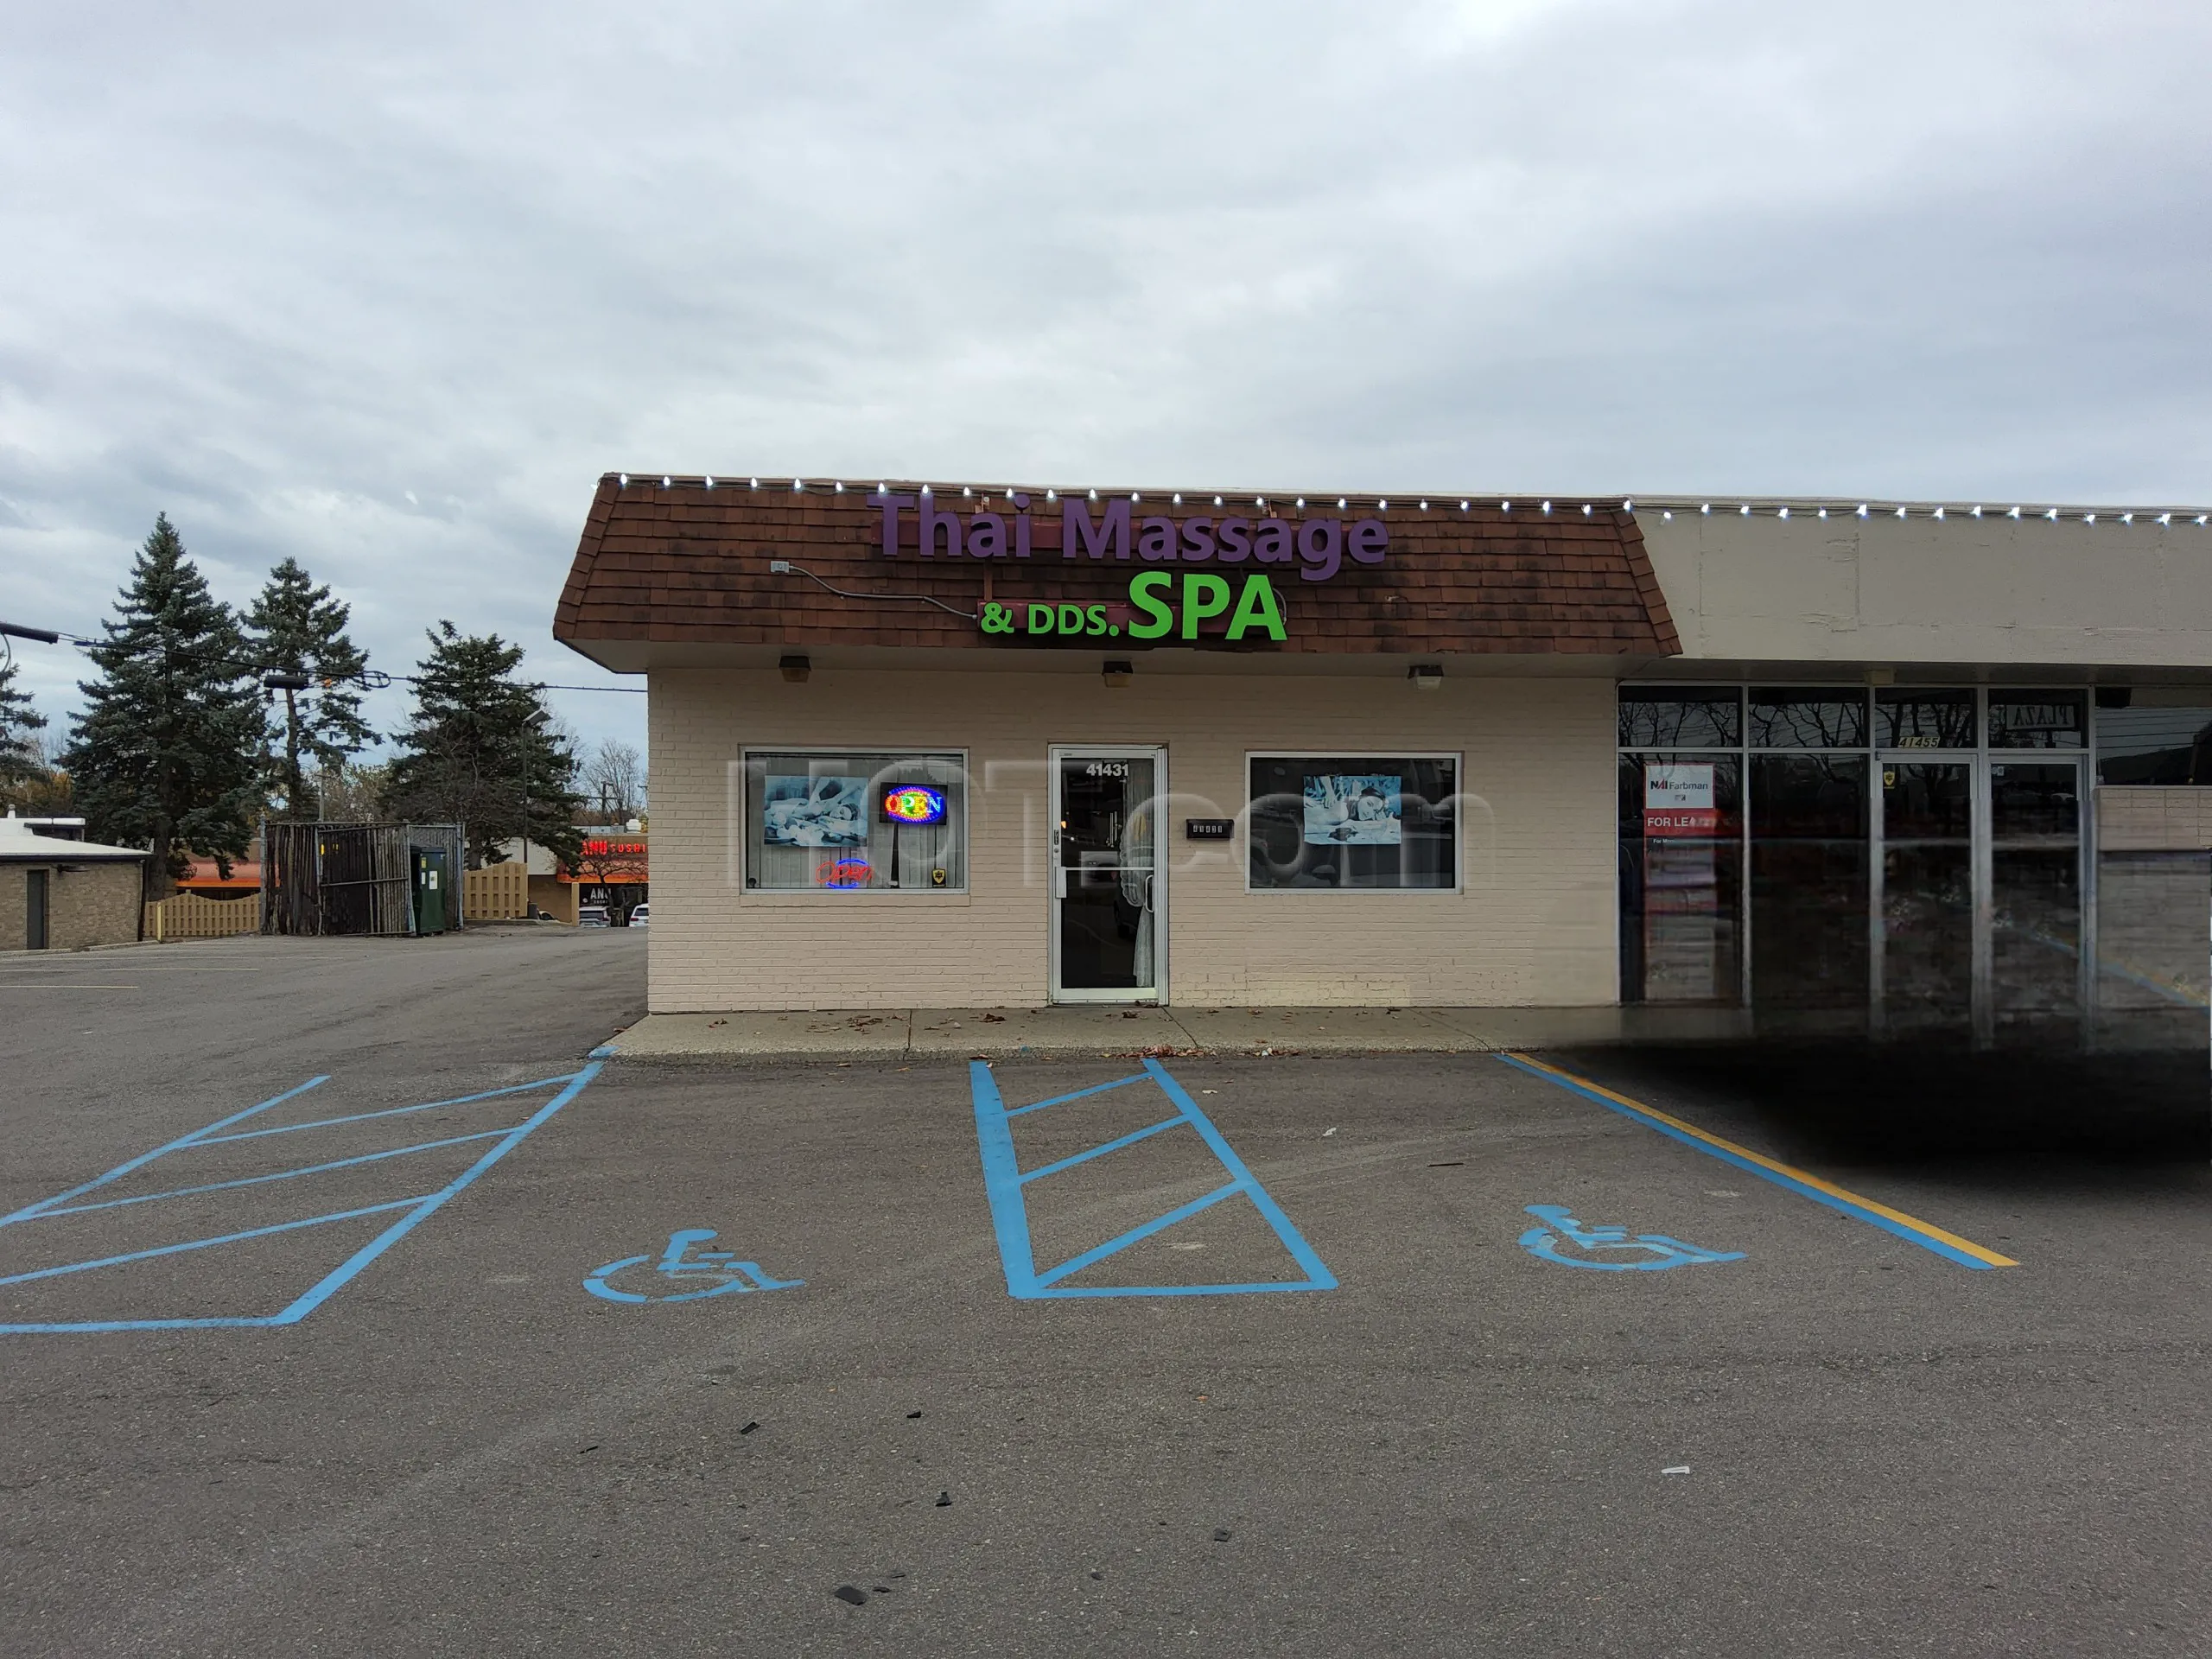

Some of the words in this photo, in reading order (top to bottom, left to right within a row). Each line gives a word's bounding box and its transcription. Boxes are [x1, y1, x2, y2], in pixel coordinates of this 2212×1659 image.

[867, 493, 1032, 558] Thai
[1062, 499, 1390, 582] Massage
[980, 602, 1014, 634] &
[1027, 604, 1120, 637] DDS.
[1128, 571, 1288, 641] SPA
[1900, 737, 1938, 748] 41455
[1086, 764, 1129, 777] 41431
[1650, 779, 1668, 790] NAI
[1669, 781, 1708, 790] Farbman
[885, 794, 943, 814] OPEN
[1647, 817, 1671, 827] FOR
